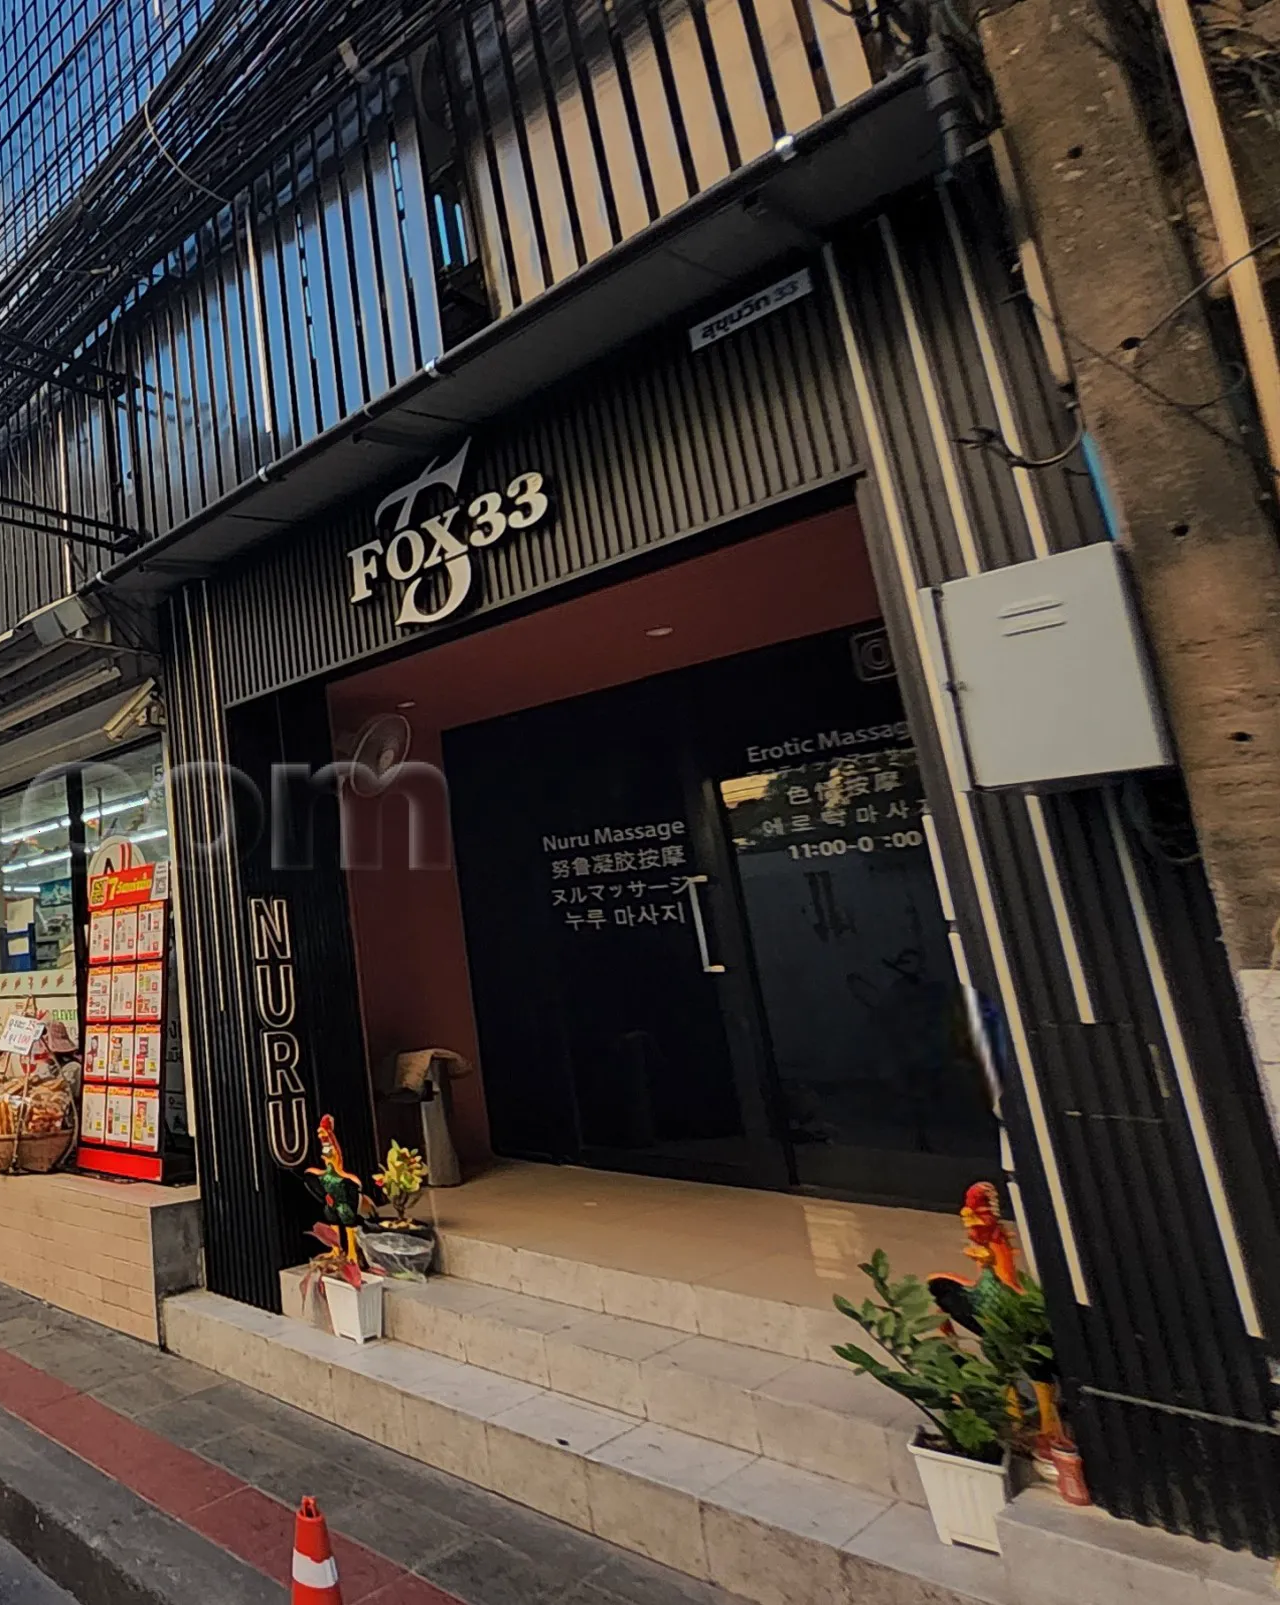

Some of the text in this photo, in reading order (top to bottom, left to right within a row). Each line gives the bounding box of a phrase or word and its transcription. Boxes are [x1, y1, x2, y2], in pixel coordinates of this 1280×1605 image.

[747, 737, 816, 763] Erotic
[817, 720, 915, 751] Massag
[543, 820, 686, 852] Nuru Massage
[788, 830, 923, 859] 11:00-0:00
[564, 901, 687, 931] 누루 마사지
[248, 897, 310, 1168] NURU
